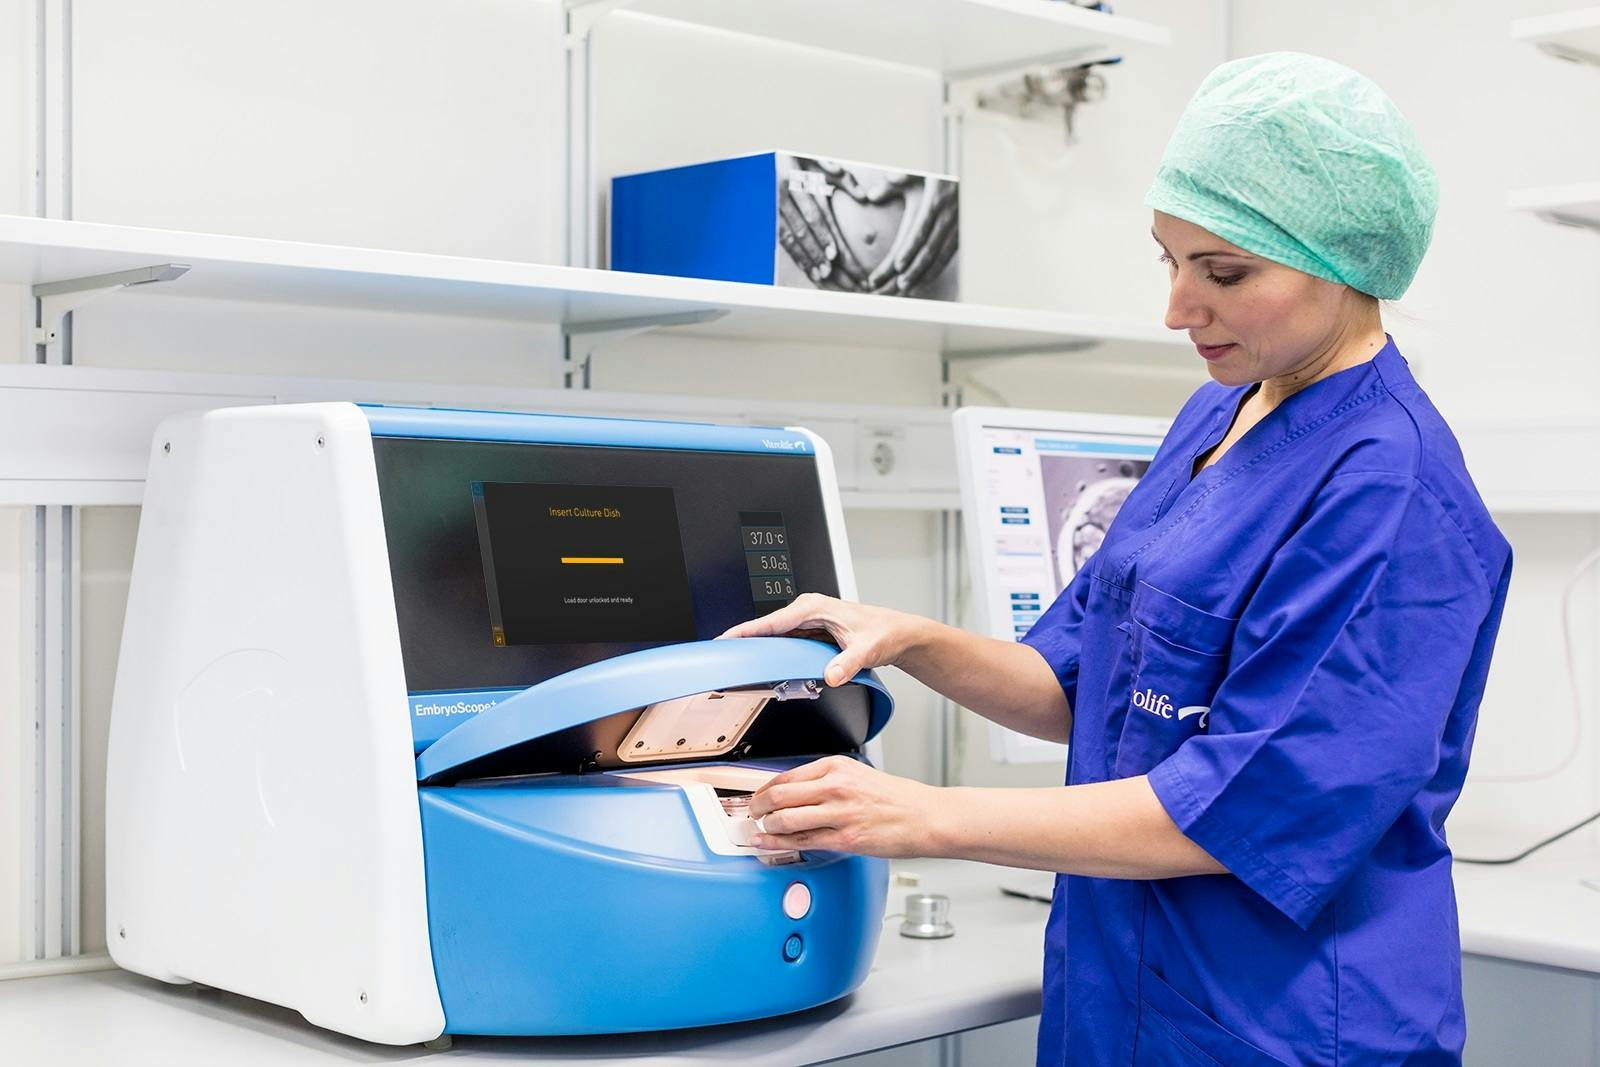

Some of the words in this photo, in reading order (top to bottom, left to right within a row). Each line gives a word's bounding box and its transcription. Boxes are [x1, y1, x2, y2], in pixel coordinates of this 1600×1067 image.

[549, 507, 573, 517] Insert
[574, 507, 602, 517] Culture
[603, 508, 621, 518] Dish
[750, 531, 773, 545] 37.0
[761, 555, 777, 569] 5.0
[765, 581, 782, 595] 5.0
[563, 596, 577, 604] Load
[577, 596, 588, 604] door
[588, 596, 610, 604] unlocked
[610, 596, 620, 604] and
[620, 596, 633, 605] ready
[1133, 688, 1174, 719] olife
